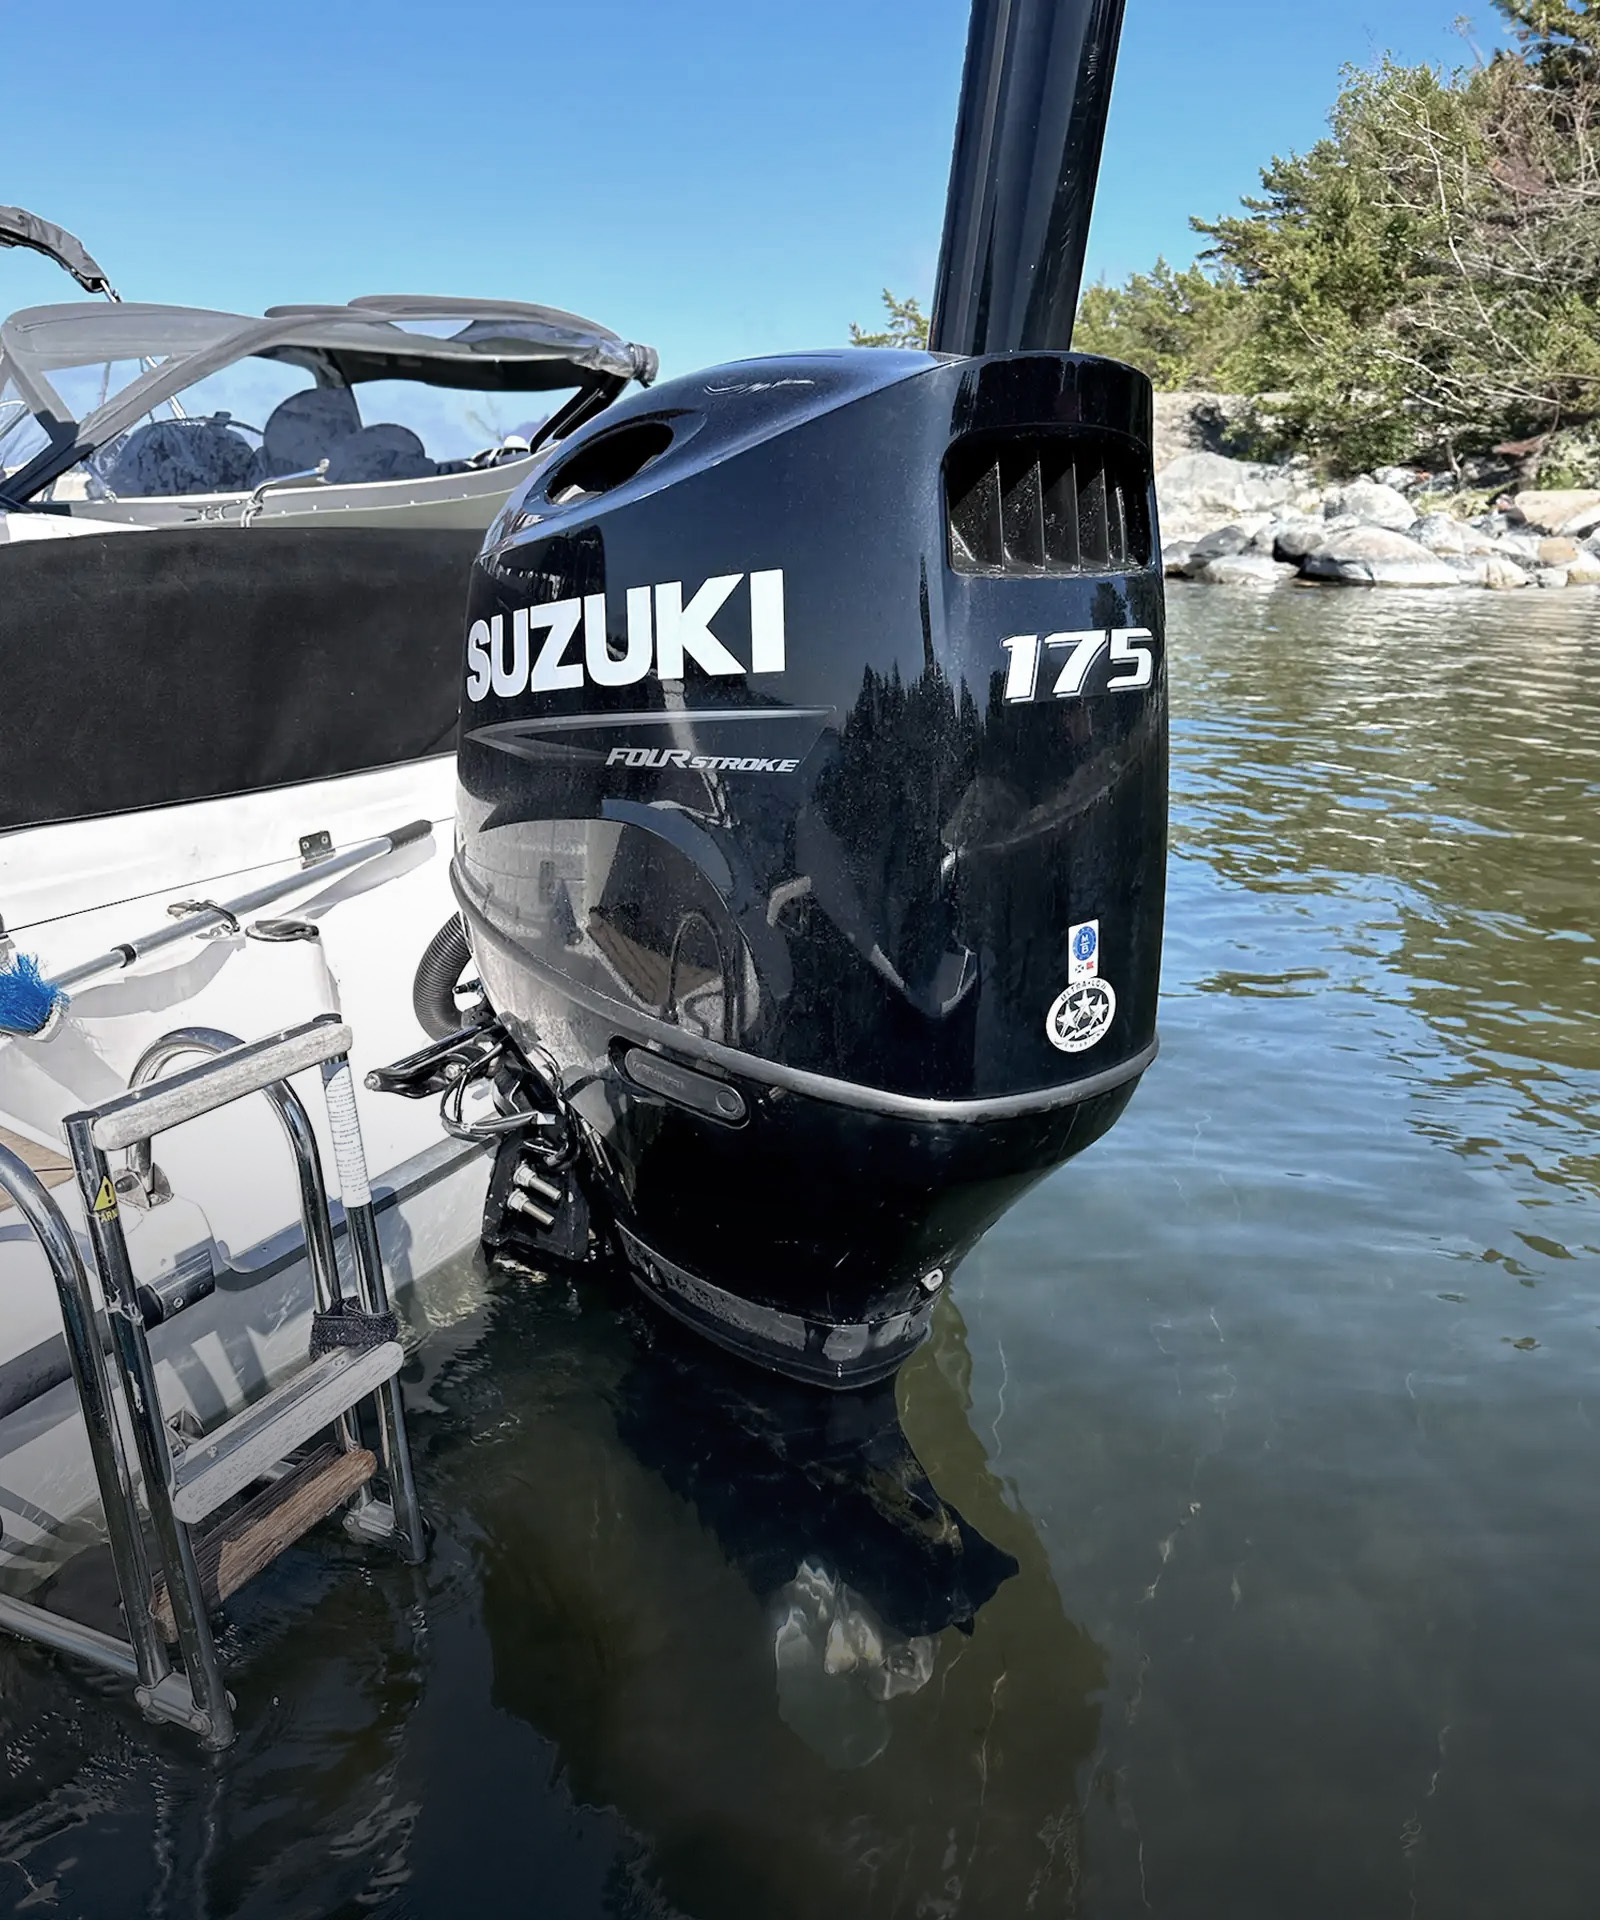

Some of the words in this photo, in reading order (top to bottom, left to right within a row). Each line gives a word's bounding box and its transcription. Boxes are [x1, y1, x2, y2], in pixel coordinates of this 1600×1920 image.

[466, 568, 786, 702] SUZUKI
[1001, 627, 1153, 703] 175
[605, 747, 691, 769] FOUR
[688, 756, 800, 773] STROKE
